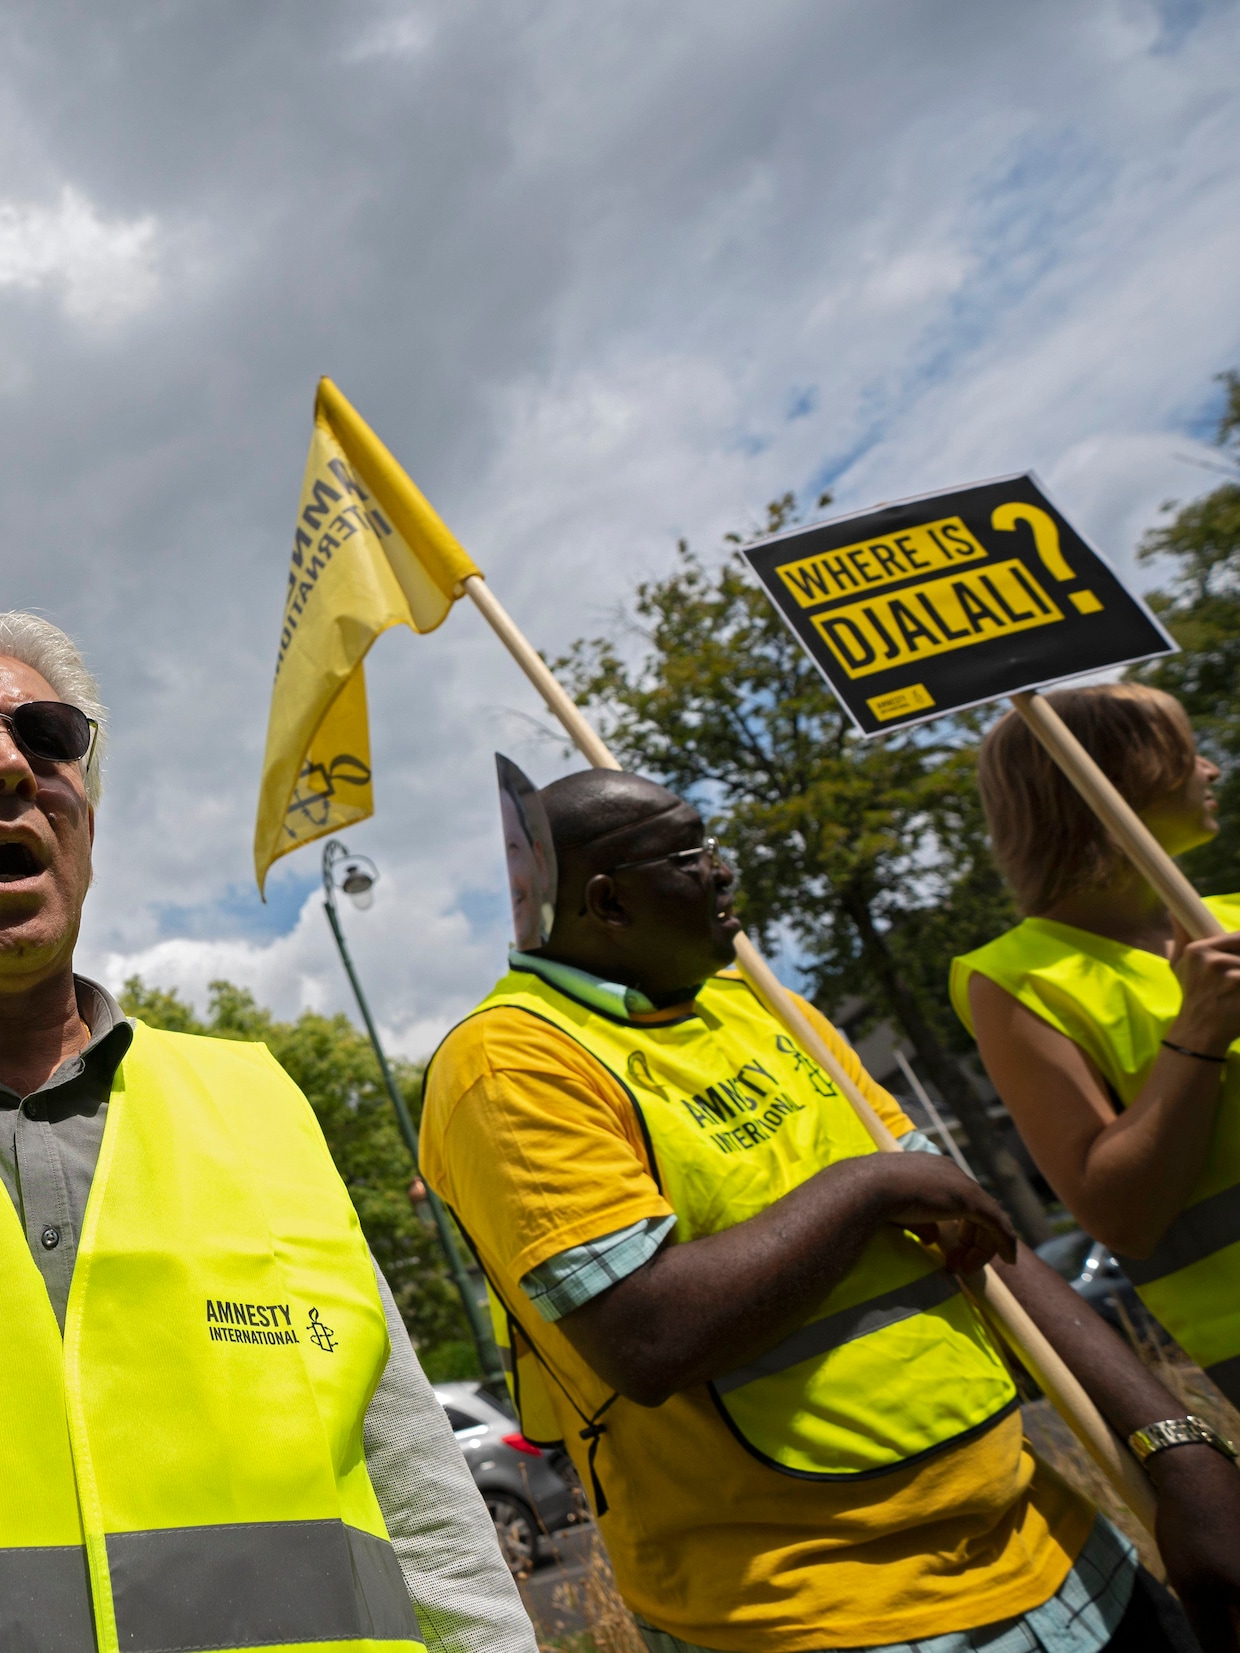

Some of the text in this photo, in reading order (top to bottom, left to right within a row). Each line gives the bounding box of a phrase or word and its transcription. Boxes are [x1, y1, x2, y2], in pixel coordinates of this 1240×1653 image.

[784, 523, 976, 601] WHERE IS
[821, 566, 1052, 670] DJALALI
[206, 1299, 292, 1328] AMNESTY
[209, 1326, 300, 1346] INTERNATIONAL
